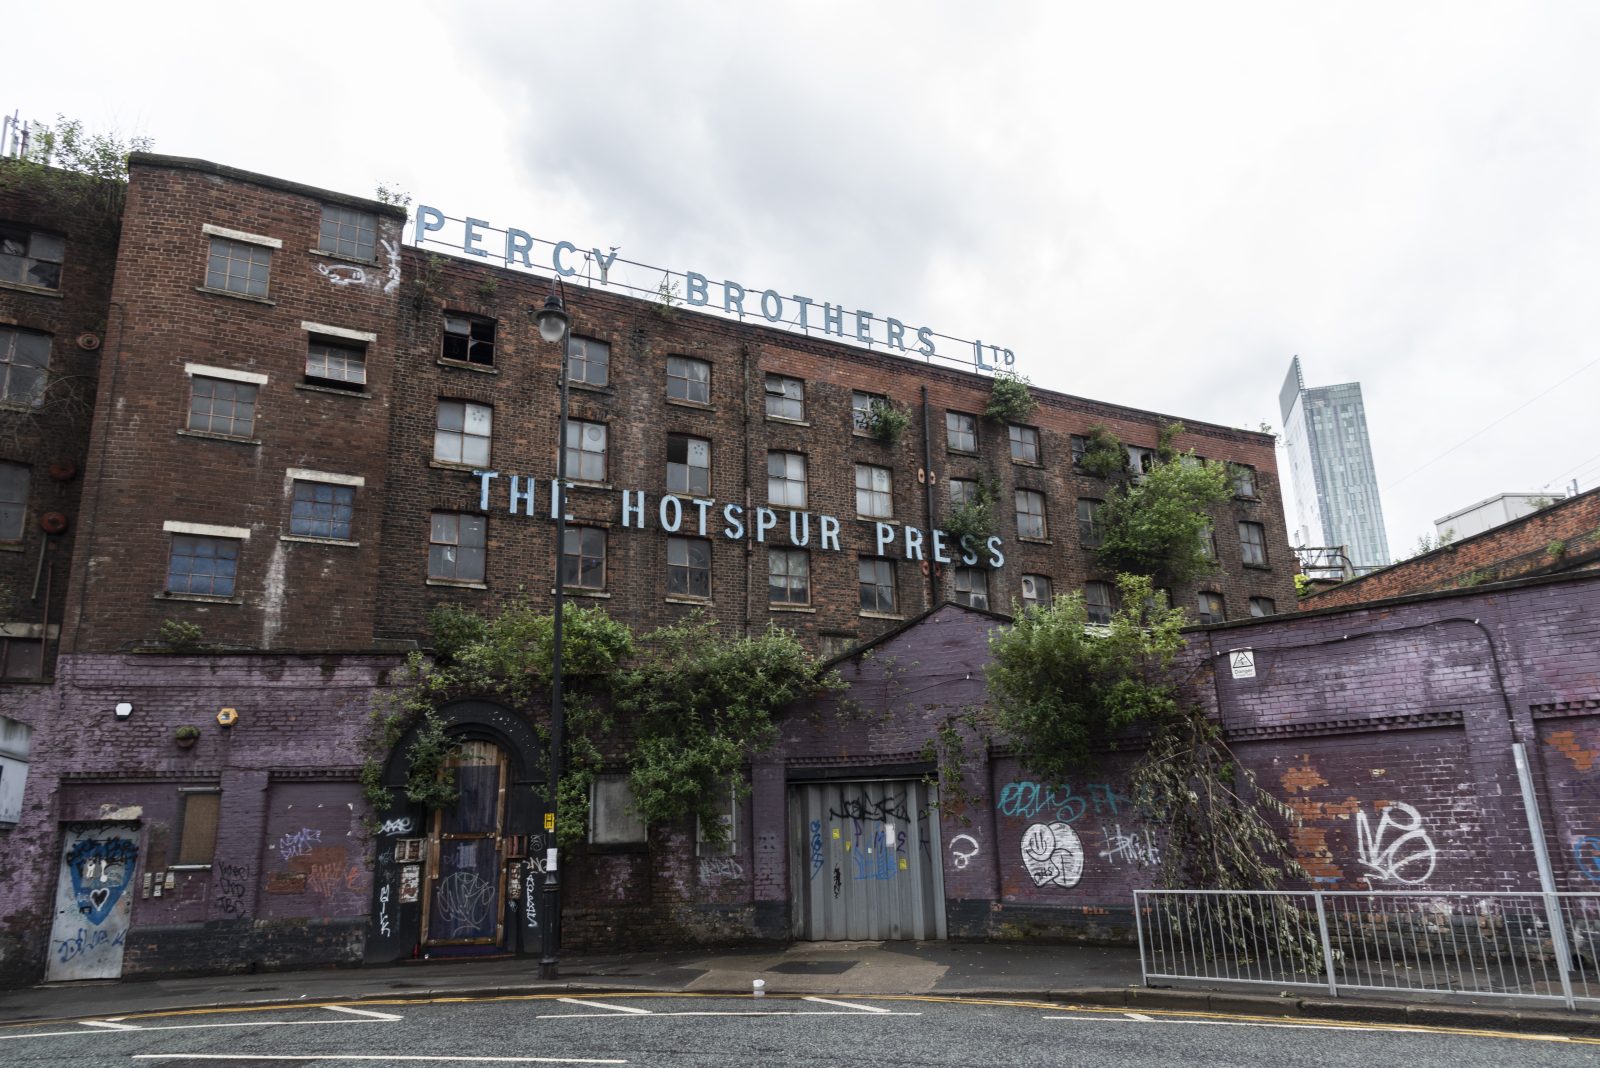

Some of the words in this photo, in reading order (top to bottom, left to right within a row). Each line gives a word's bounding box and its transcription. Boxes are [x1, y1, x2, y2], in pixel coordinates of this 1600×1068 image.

[415, 204, 617, 286] PERCY
[686, 270, 936, 357] BROTHERS
[975, 339, 1015, 371] LTD
[473, 469, 575, 521] THE
[622, 489, 841, 551] HOTSPUR
[876, 521, 1005, 568] PRESS
